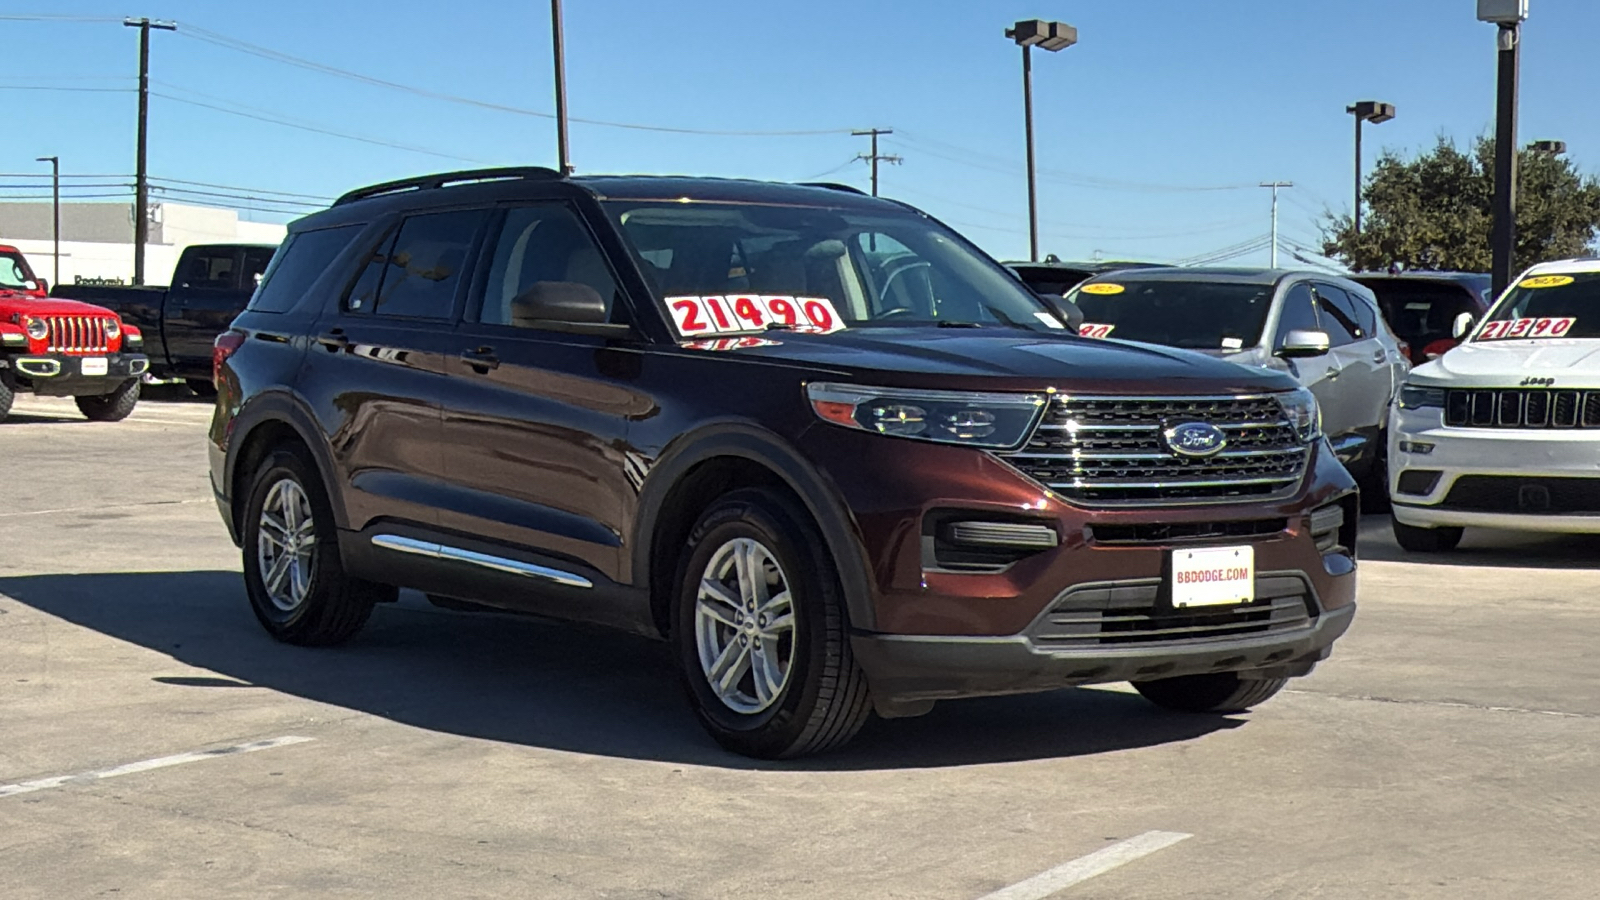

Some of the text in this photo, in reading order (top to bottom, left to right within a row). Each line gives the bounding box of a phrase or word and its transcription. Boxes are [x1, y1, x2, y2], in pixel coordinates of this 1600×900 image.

[672, 298, 833, 331] 21490
[1480, 319, 1571, 338] 21390
[1520, 376, 1555, 387] Jeep
[1181, 428, 1215, 446] Ford
[1177, 567, 1248, 583] BBDODGE.COM
